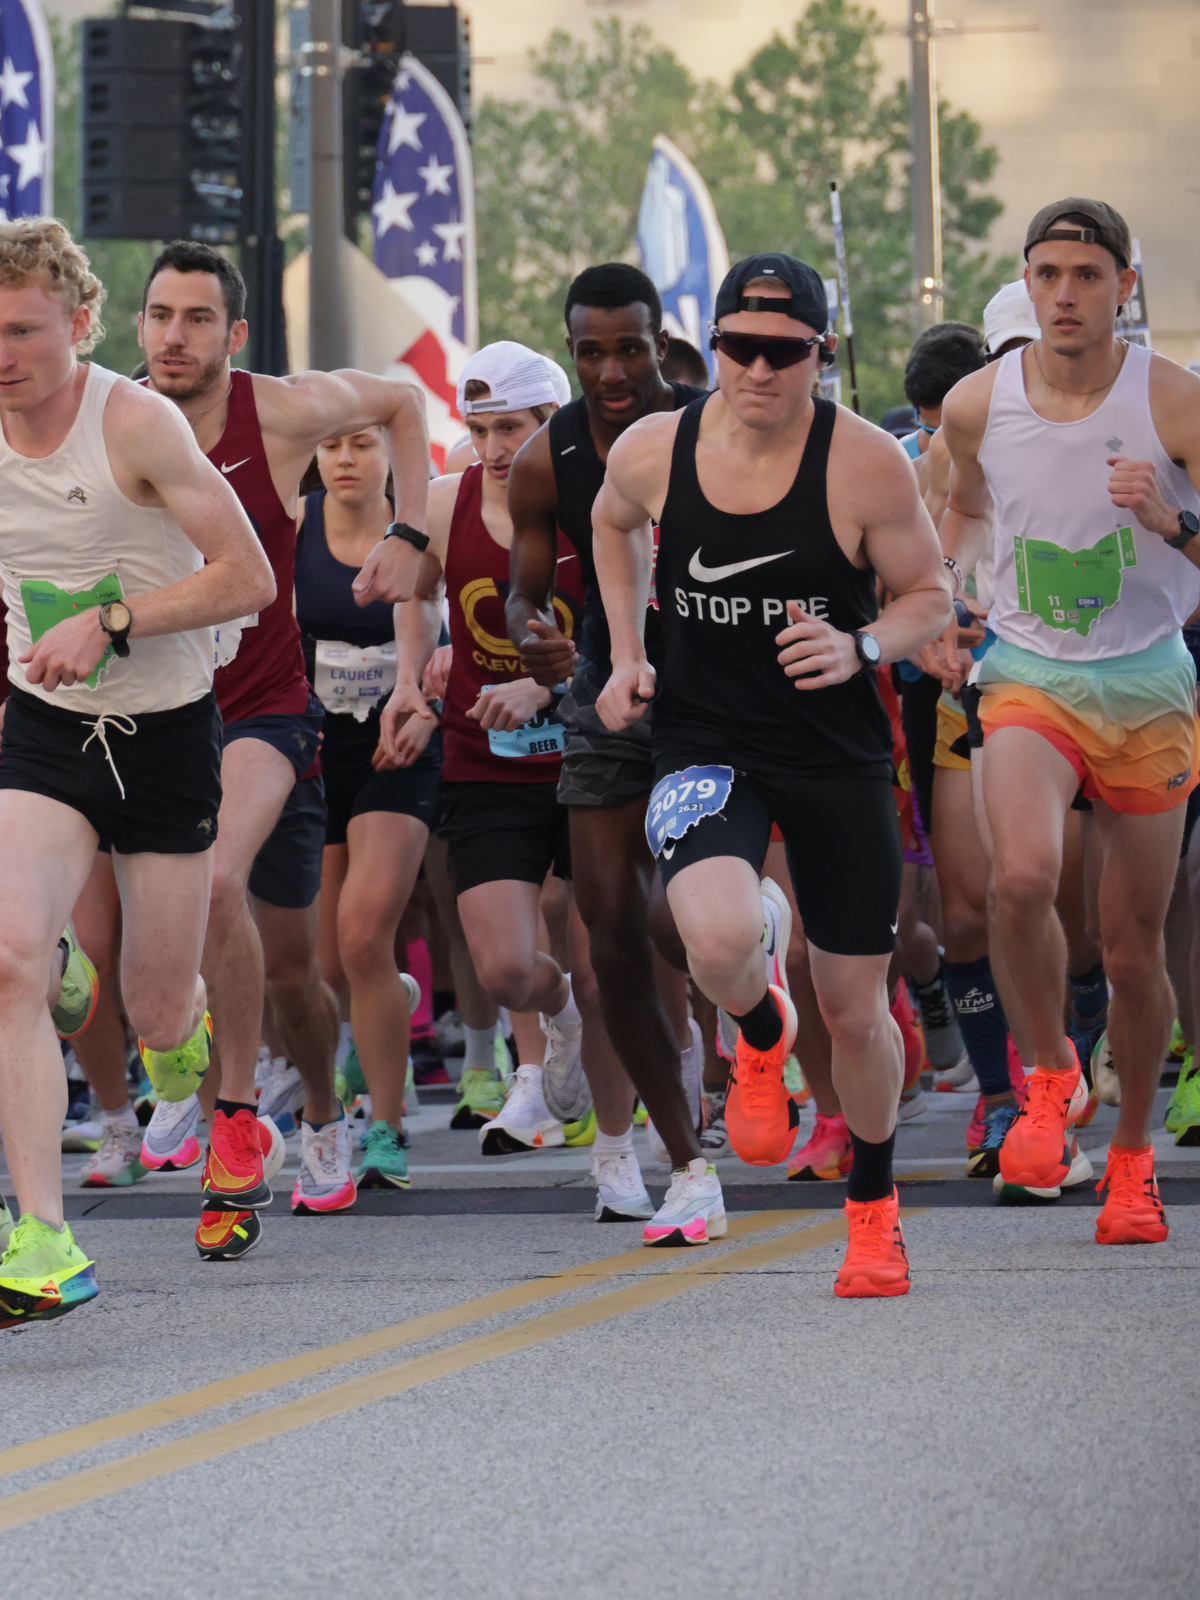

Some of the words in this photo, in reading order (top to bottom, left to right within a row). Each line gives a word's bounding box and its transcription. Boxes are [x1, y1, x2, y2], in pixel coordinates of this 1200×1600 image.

[674, 587, 751, 626] STOP
[1048, 595, 1060, 607] 11
[1078, 598, 1096, 606] Elite
[330, 668, 383, 681] LAUREN
[333, 686, 346, 695] 42
[529, 738, 558, 754] BEER
[651, 779, 716, 828] 2079
[677, 804, 698, 813] 26.2
[955, 993, 993, 1008] UTMB
